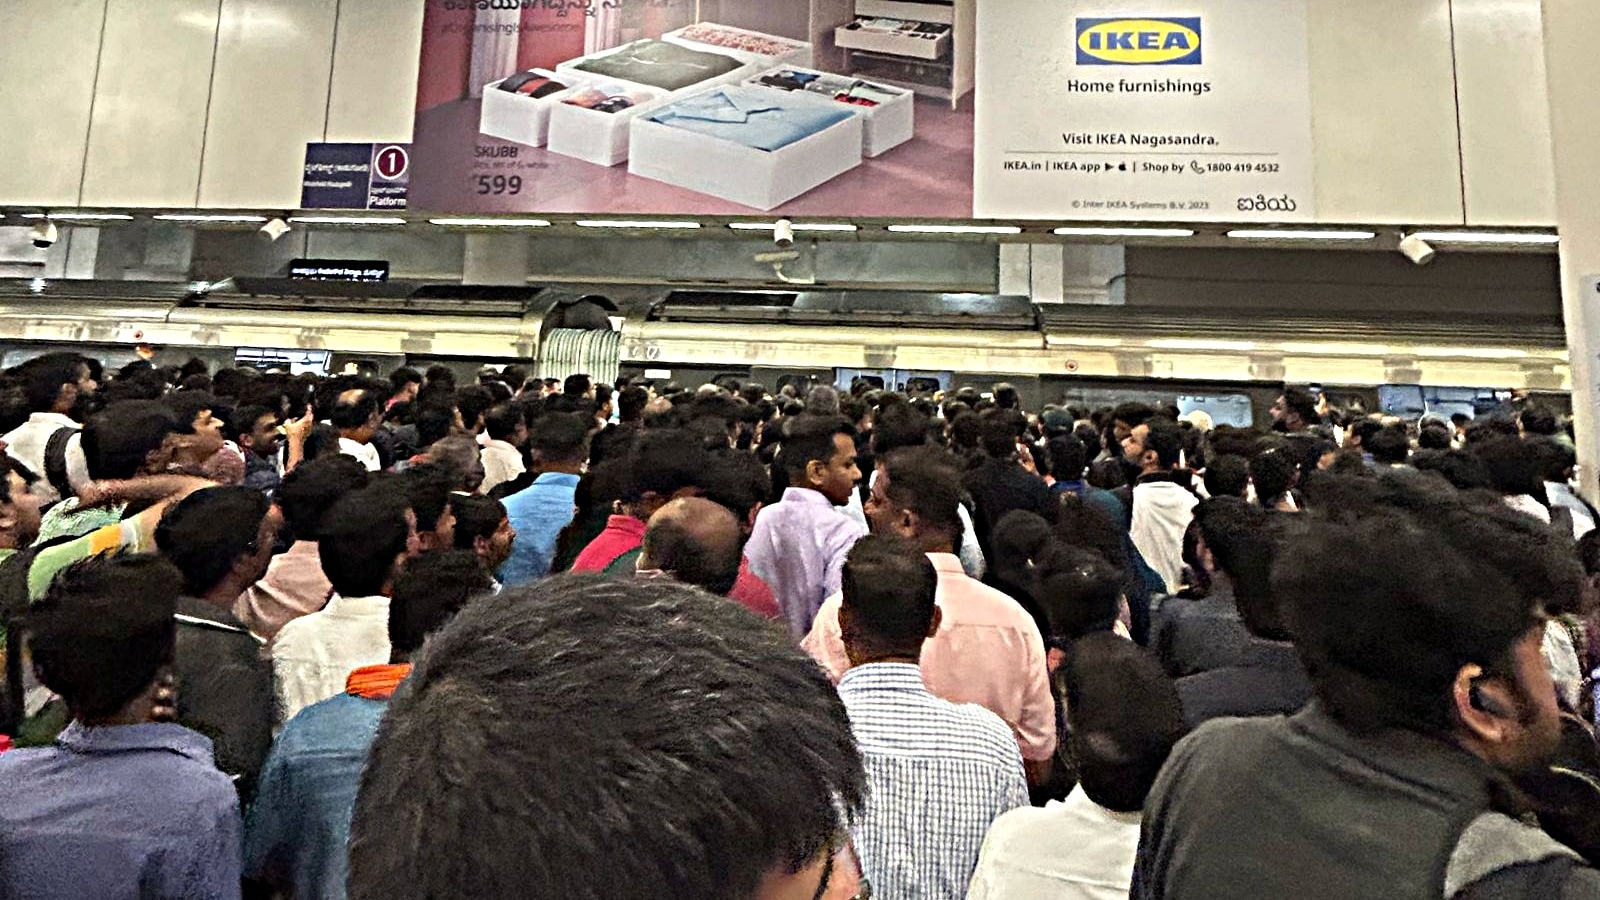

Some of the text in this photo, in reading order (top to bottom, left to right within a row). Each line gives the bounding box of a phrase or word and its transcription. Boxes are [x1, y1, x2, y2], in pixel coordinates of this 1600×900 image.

[1089, 32, 1190, 50] IKEA
[1067, 79, 1211, 95] Home furnishings
[1062, 133, 1092, 145] Visit
[1096, 133, 1127, 145] IKEA
[388, 152, 396, 173] 1
[1004, 161, 1041, 170] IKEA.in
[1053, 162, 1077, 171] IKEA
[1080, 163, 1101, 174] app
[1142, 162, 1168, 174] Shop
[1171, 163, 1185, 174] by
[1206, 163, 1232, 172] 1800
[1234, 163, 1252, 172] 419
[1254, 163, 1280, 172] 4532
[477, 175, 522, 195] 599
[369, 196, 407, 206] Platform
